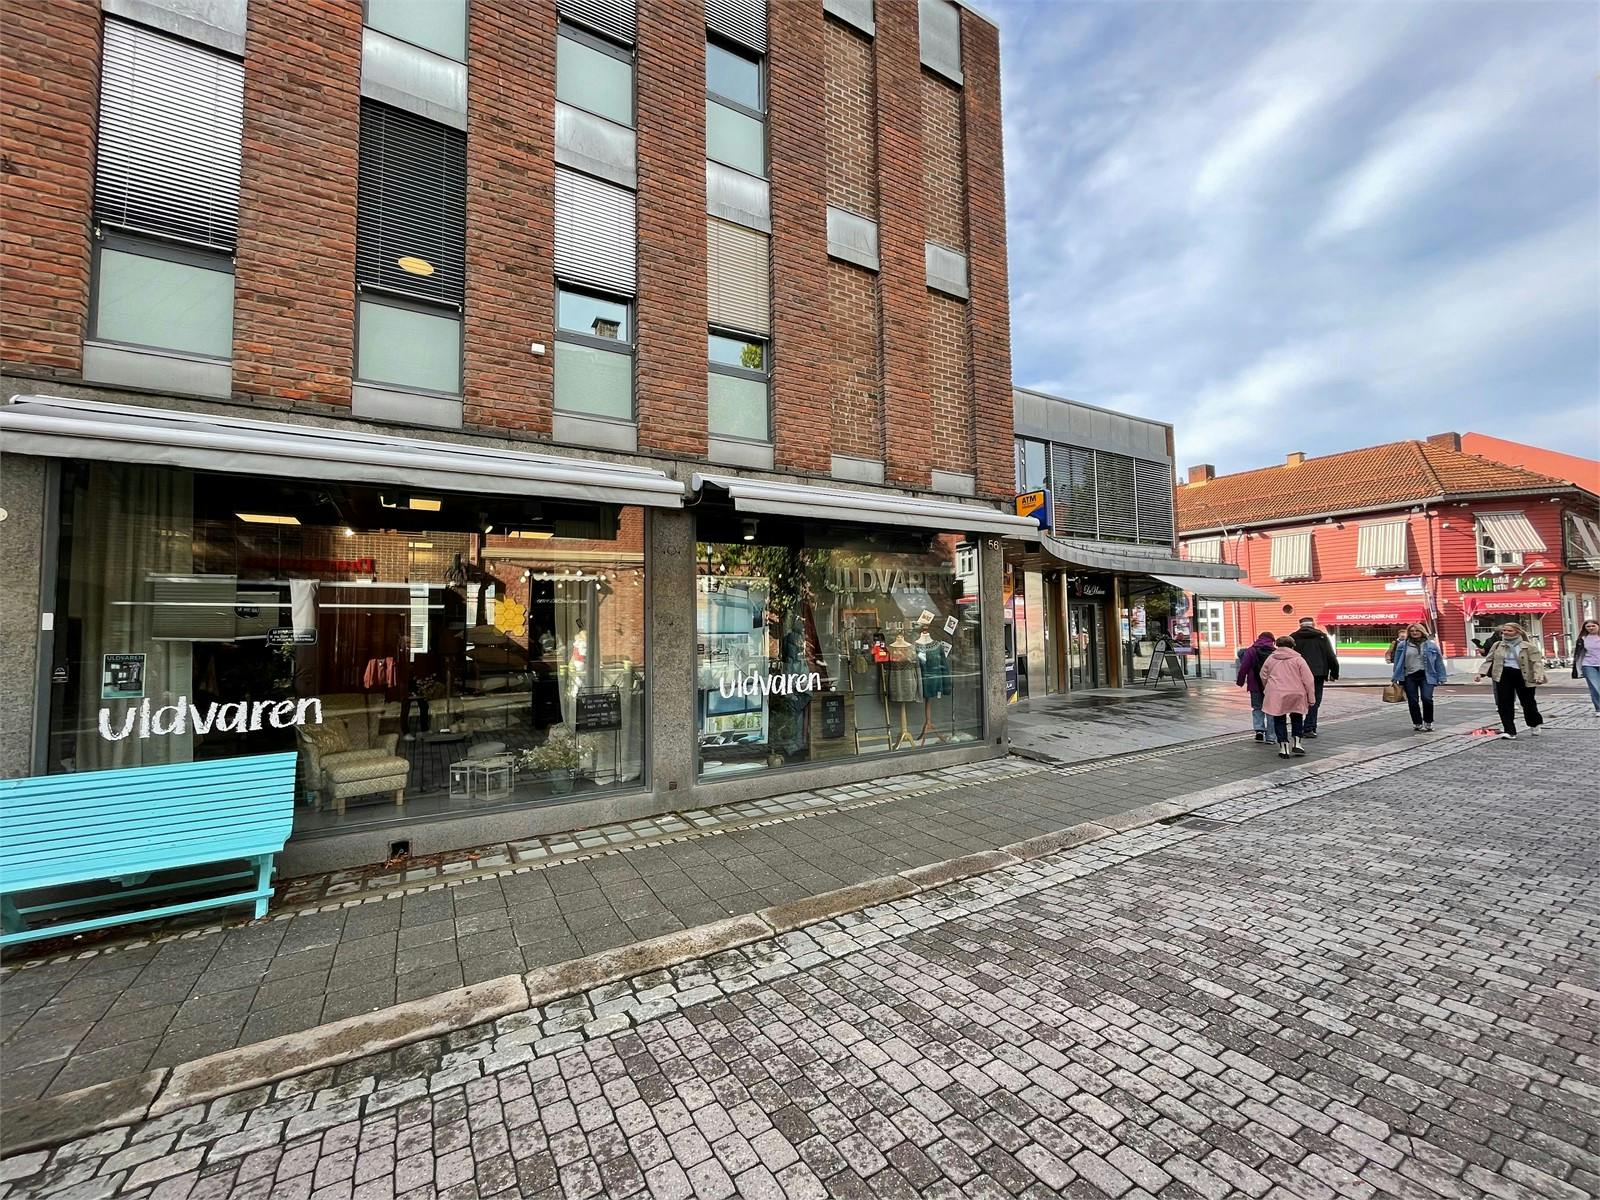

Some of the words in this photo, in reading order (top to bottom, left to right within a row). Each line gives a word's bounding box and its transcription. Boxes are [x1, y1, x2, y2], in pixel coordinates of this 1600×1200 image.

[1022, 495, 1037, 504] ATM
[988, 540, 999, 550] 56
[1456, 577, 1493, 592] KIWI
